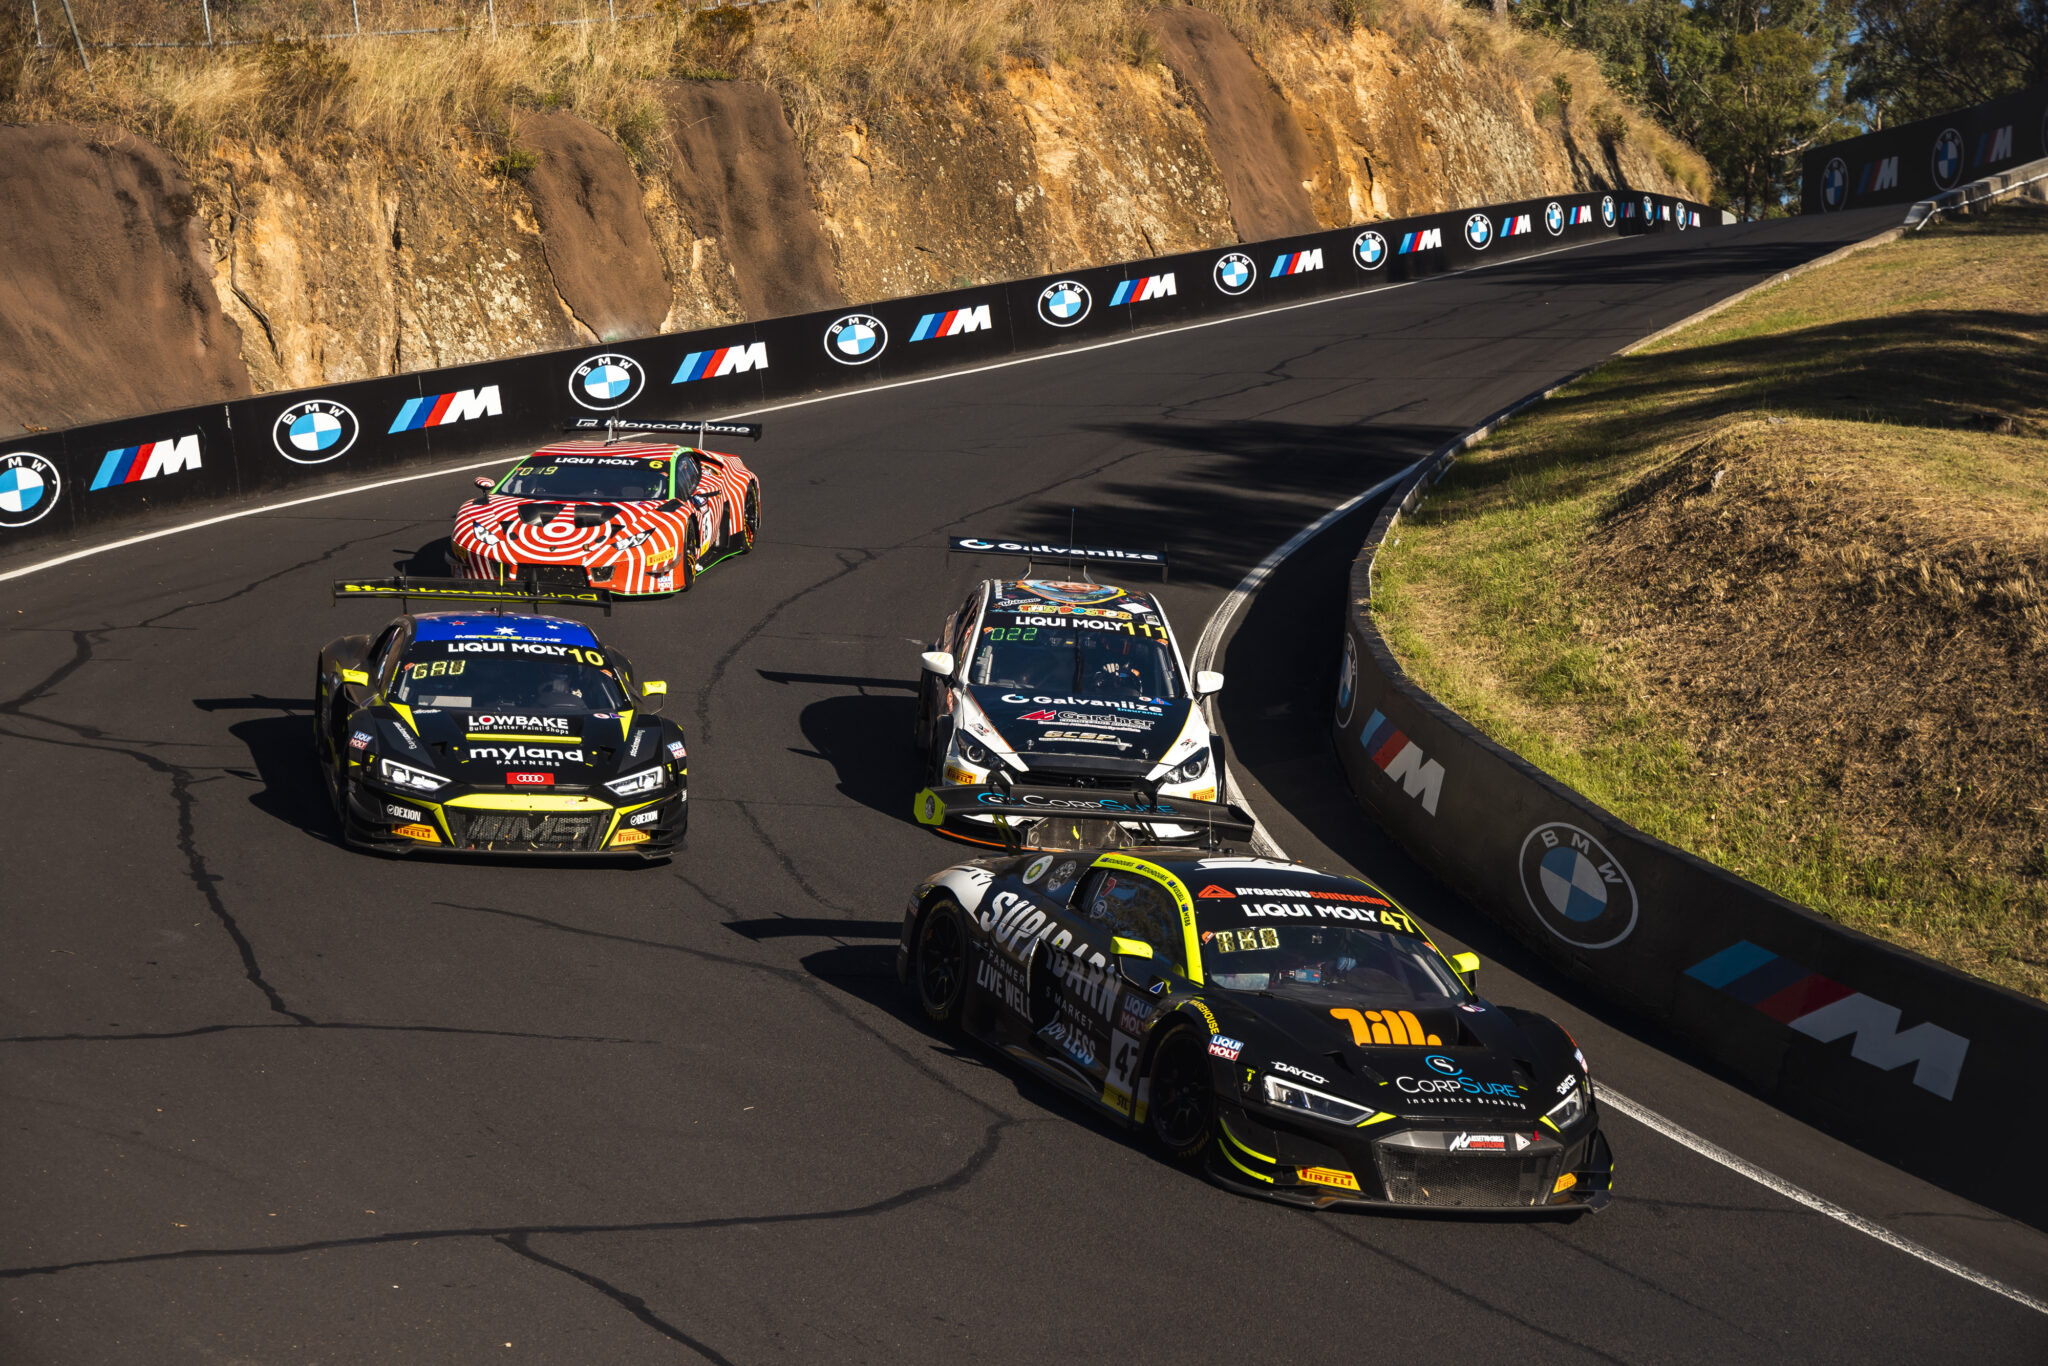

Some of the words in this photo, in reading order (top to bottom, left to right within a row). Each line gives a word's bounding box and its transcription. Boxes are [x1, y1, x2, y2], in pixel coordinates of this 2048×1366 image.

[1514, 214, 1531, 235] M
[1357, 233, 1382, 246] BMW
[1418, 228, 1442, 251] M
[1217, 255, 1250, 270] BMW
[1294, 248, 1323, 273] M
[1046, 283, 1083, 299] BMW
[1139, 273, 1177, 301] M
[832, 316, 877, 335] BMW
[947, 305, 991, 335] M
[578, 356, 633, 376] BMW
[716, 342, 768, 378] M
[282, 402, 346, 425] BMW
[440, 385, 502, 426] M
[139, 434, 202, 481] M
[649, 460, 663, 469] 6
[1019, 605, 1056, 614] THE
[1058, 606, 1132, 620] DOCTOR
[990, 628, 1038, 641] 022
[1016, 617, 1066, 627] LIQUI
[1073, 619, 1124, 631] MOLY
[1123, 622, 1168, 640] 111
[448, 643, 505, 653] LIQUI
[512, 643, 567, 656] MOLY
[568, 648, 604, 666] 10
[468, 715, 569, 730] LOWBAKE
[1058, 711, 1155, 727] Gardner
[353, 731, 374, 743] LIQUI
[546, 726, 569, 735] Shops
[350, 739, 368, 750] MOLY
[470, 746, 584, 762] myland
[1384, 742, 1445, 817] M
[394, 806, 421, 822] DEXION
[637, 810, 658, 824] DEXION
[394, 824, 431, 839] PIRELLI
[617, 832, 649, 843] PIRELLI
[1541, 829, 1623, 886] BMW
[1241, 904, 1313, 918] LIQUI
[1314, 905, 1379, 922] MOLY
[1379, 911, 1415, 933] 47
[976, 959, 1002, 998] LIVE
[1005, 979, 1034, 1024] WELL
[1054, 993, 1093, 1031] MARKET
[1036, 1010, 1066, 1040] for
[1063, 1024, 1096, 1065] LESS
[1213, 1035, 1241, 1050] LIQUI
[1789, 992, 1970, 1101] M
[1209, 1044, 1238, 1059] MOLY
[1271, 1061, 1329, 1084] DAYCO
[1556, 1073, 1576, 1096] DAYCO
[1407, 1097, 1471, 1105] Insurance
[1478, 1097, 1527, 1110] Broking
[1302, 1168, 1352, 1187] PIRELLI
